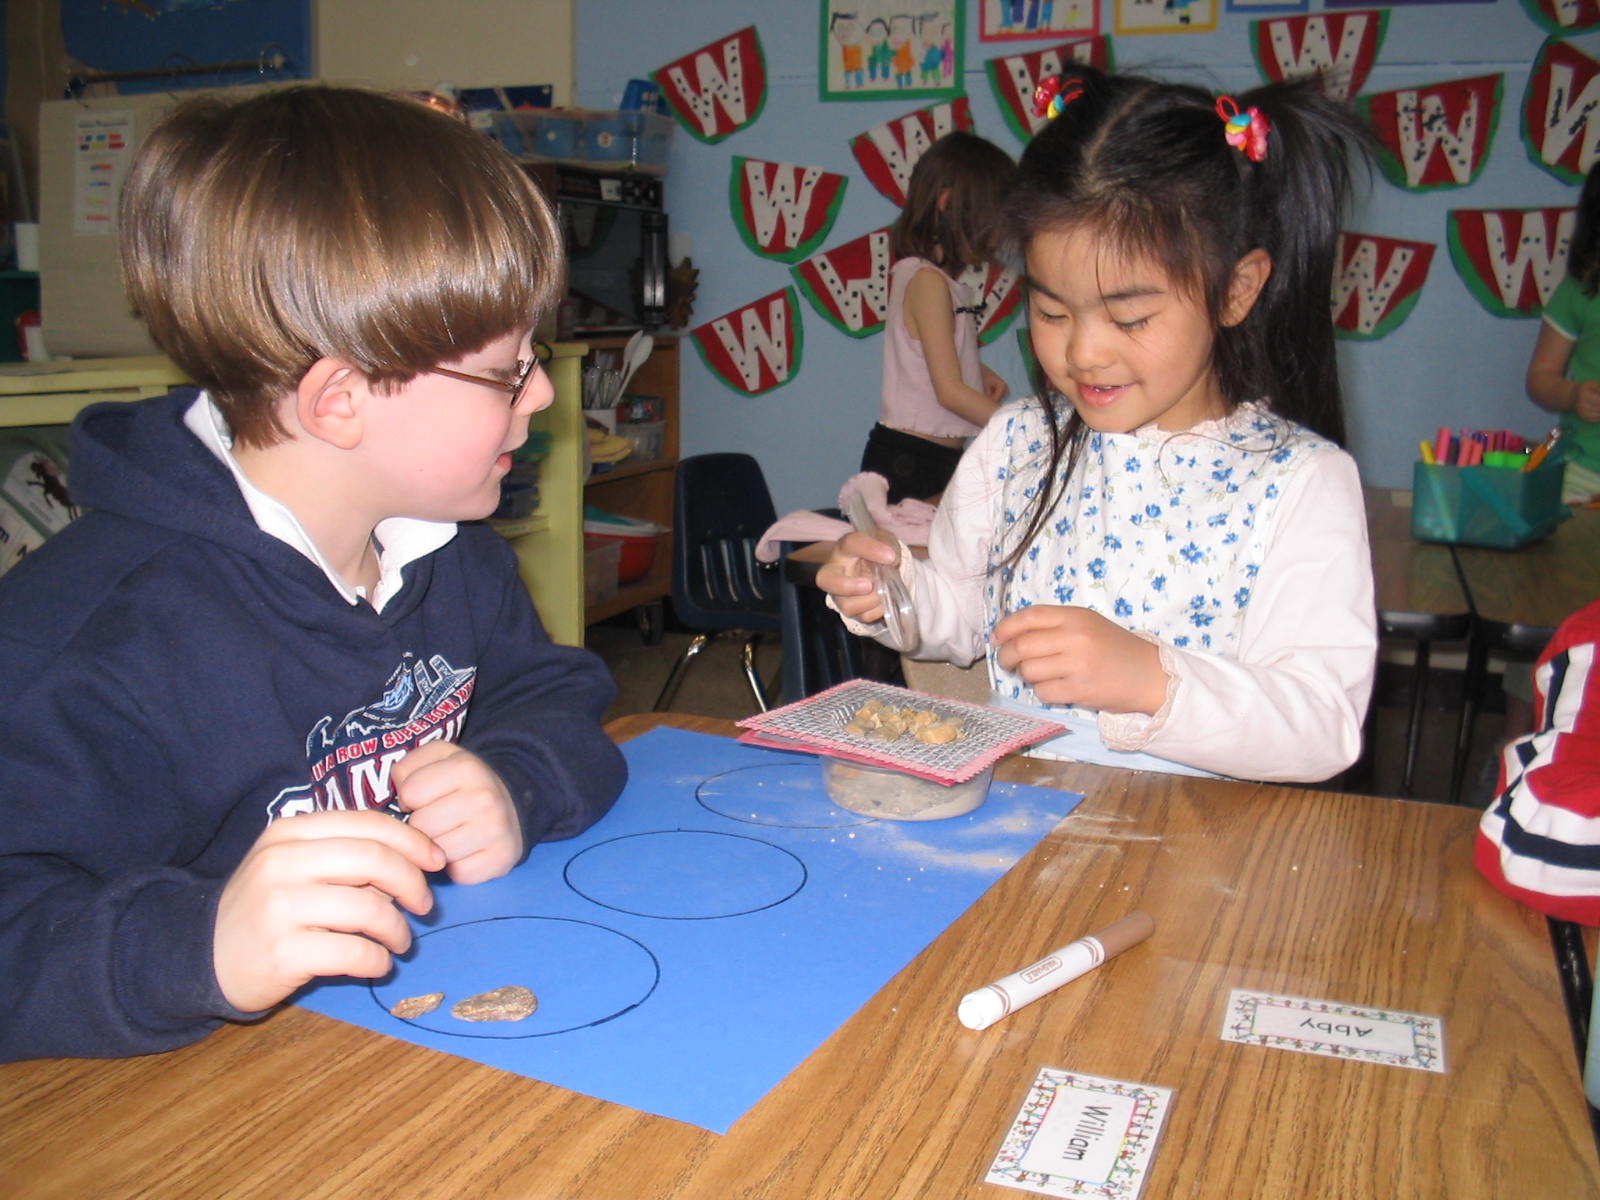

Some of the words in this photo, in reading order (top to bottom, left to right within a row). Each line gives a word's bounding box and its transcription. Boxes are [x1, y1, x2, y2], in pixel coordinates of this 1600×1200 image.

[667, 38, 746, 137] W
[1269, 16, 1369, 100] W
[1396, 90, 1478, 187] W
[745, 160, 823, 248] W
[811, 231, 890, 331] W
[1483, 211, 1578, 309] W
[712, 297, 788, 391] W
[336, 738, 378, 764] ROW
[383, 719, 431, 748] SUPER
[428, 698, 459, 724] BOWL
[1299, 1016, 1374, 1040] Abby
[1062, 1104, 1112, 1162] William
